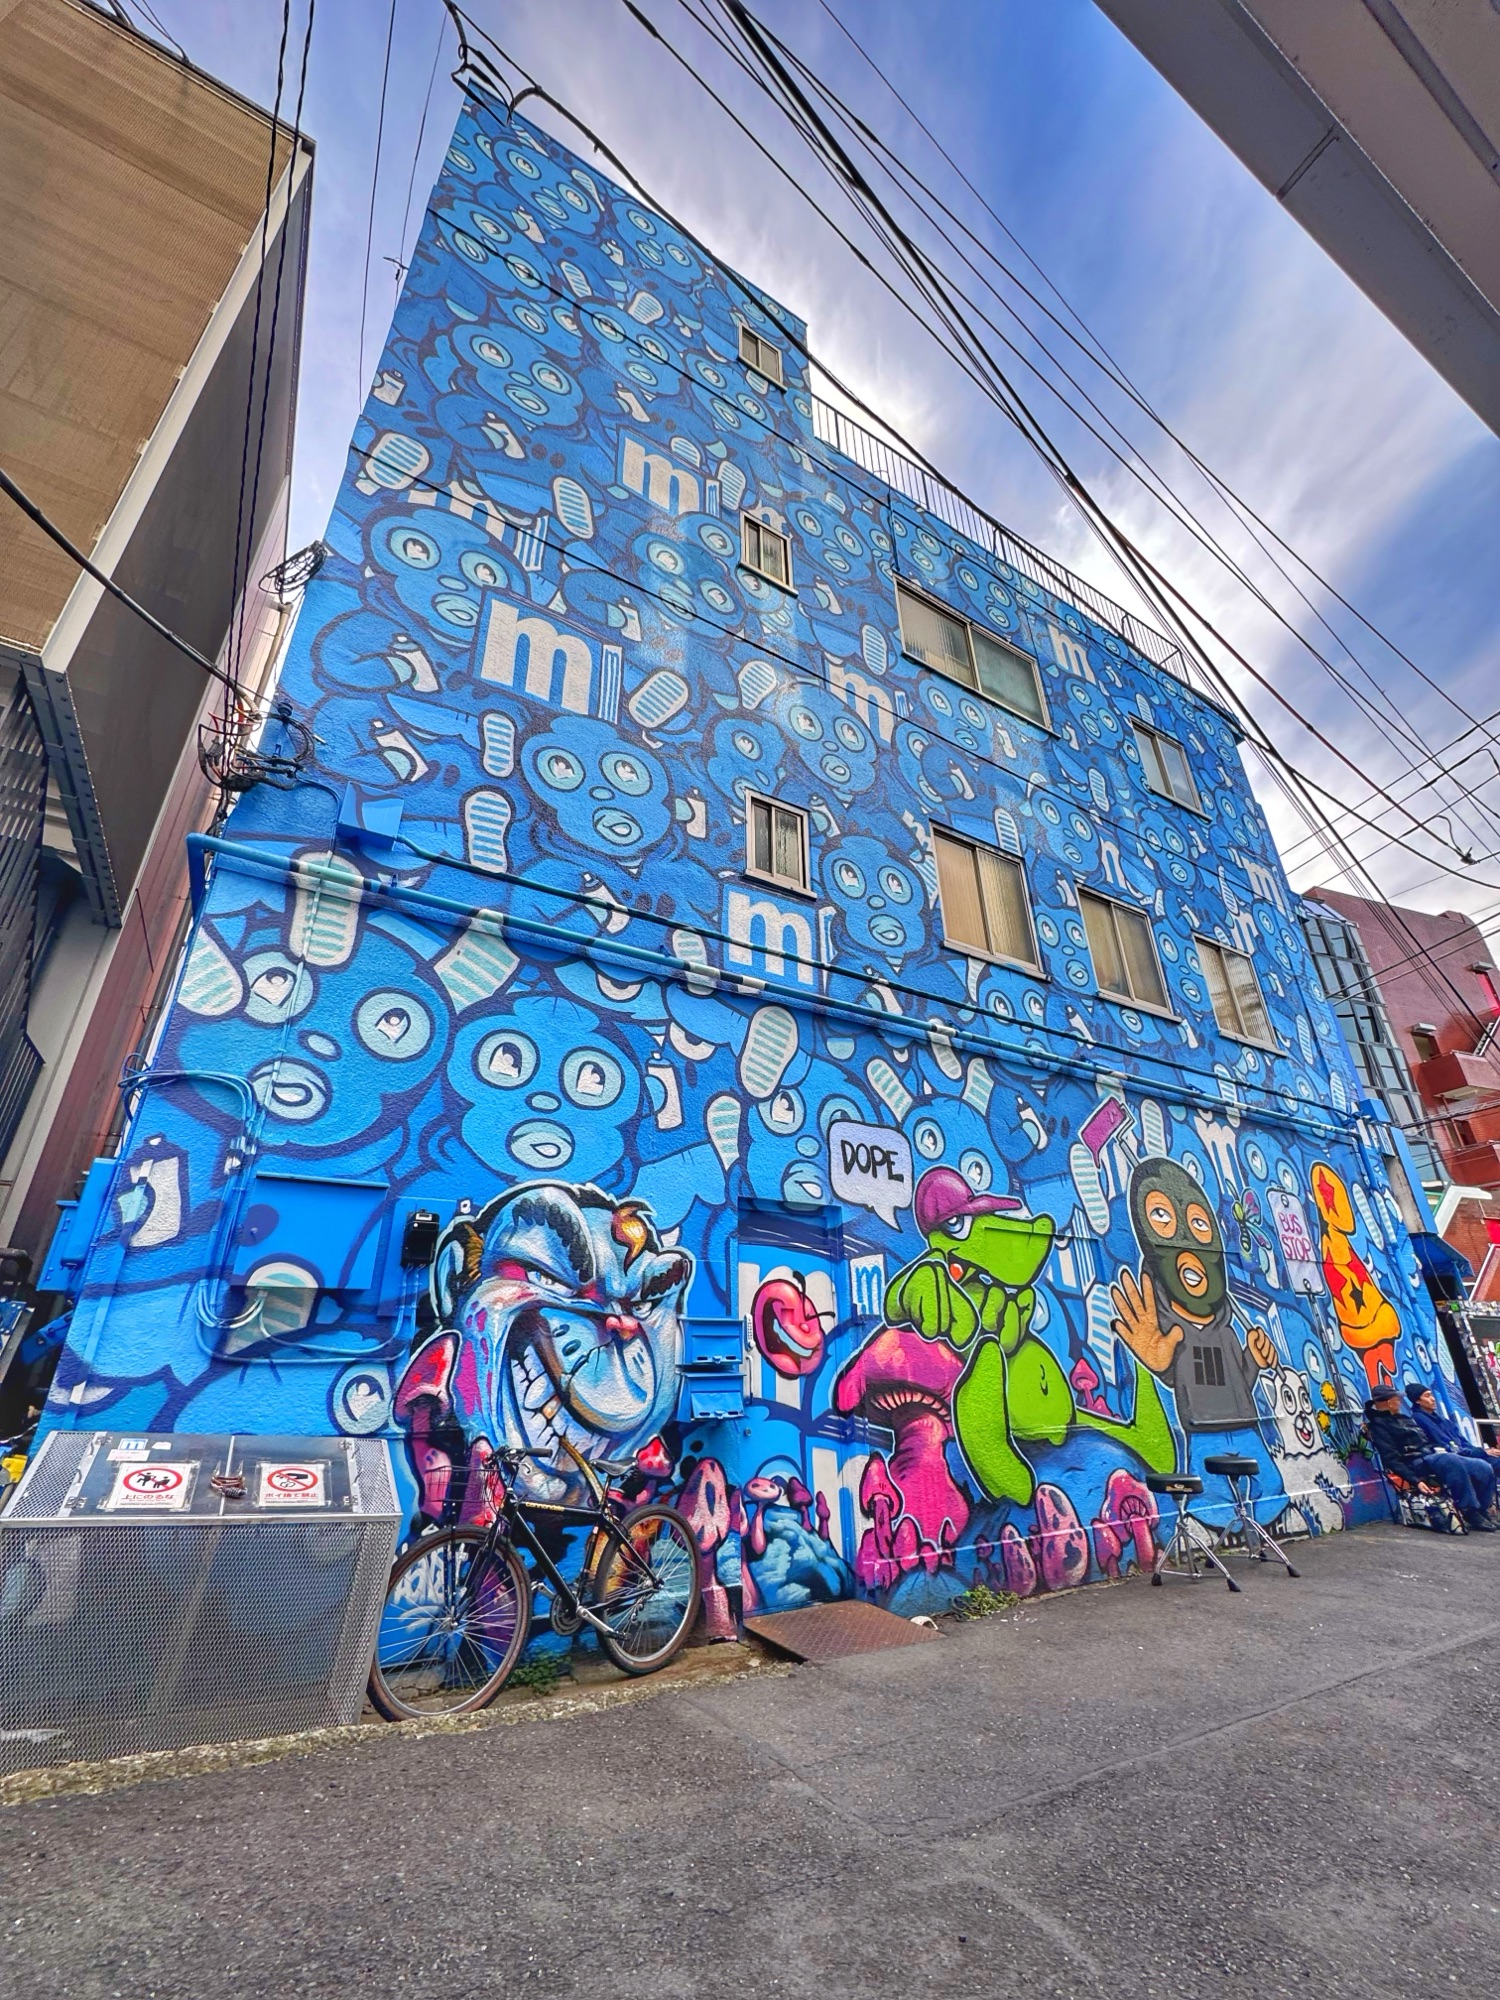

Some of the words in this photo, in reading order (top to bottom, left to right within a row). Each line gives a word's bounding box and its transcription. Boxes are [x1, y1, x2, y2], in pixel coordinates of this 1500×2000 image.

[623, 437, 699, 516] m
[480, 599, 592, 715] m
[1048, 624, 1097, 685] m
[829, 663, 894, 743] m
[728, 891, 813, 986] m
[841, 1139, 904, 1183] DOPE
[1278, 1212, 1302, 1235] BUS
[1281, 1234, 1311, 1262] STOP
[855, 1265, 882, 1315] m
